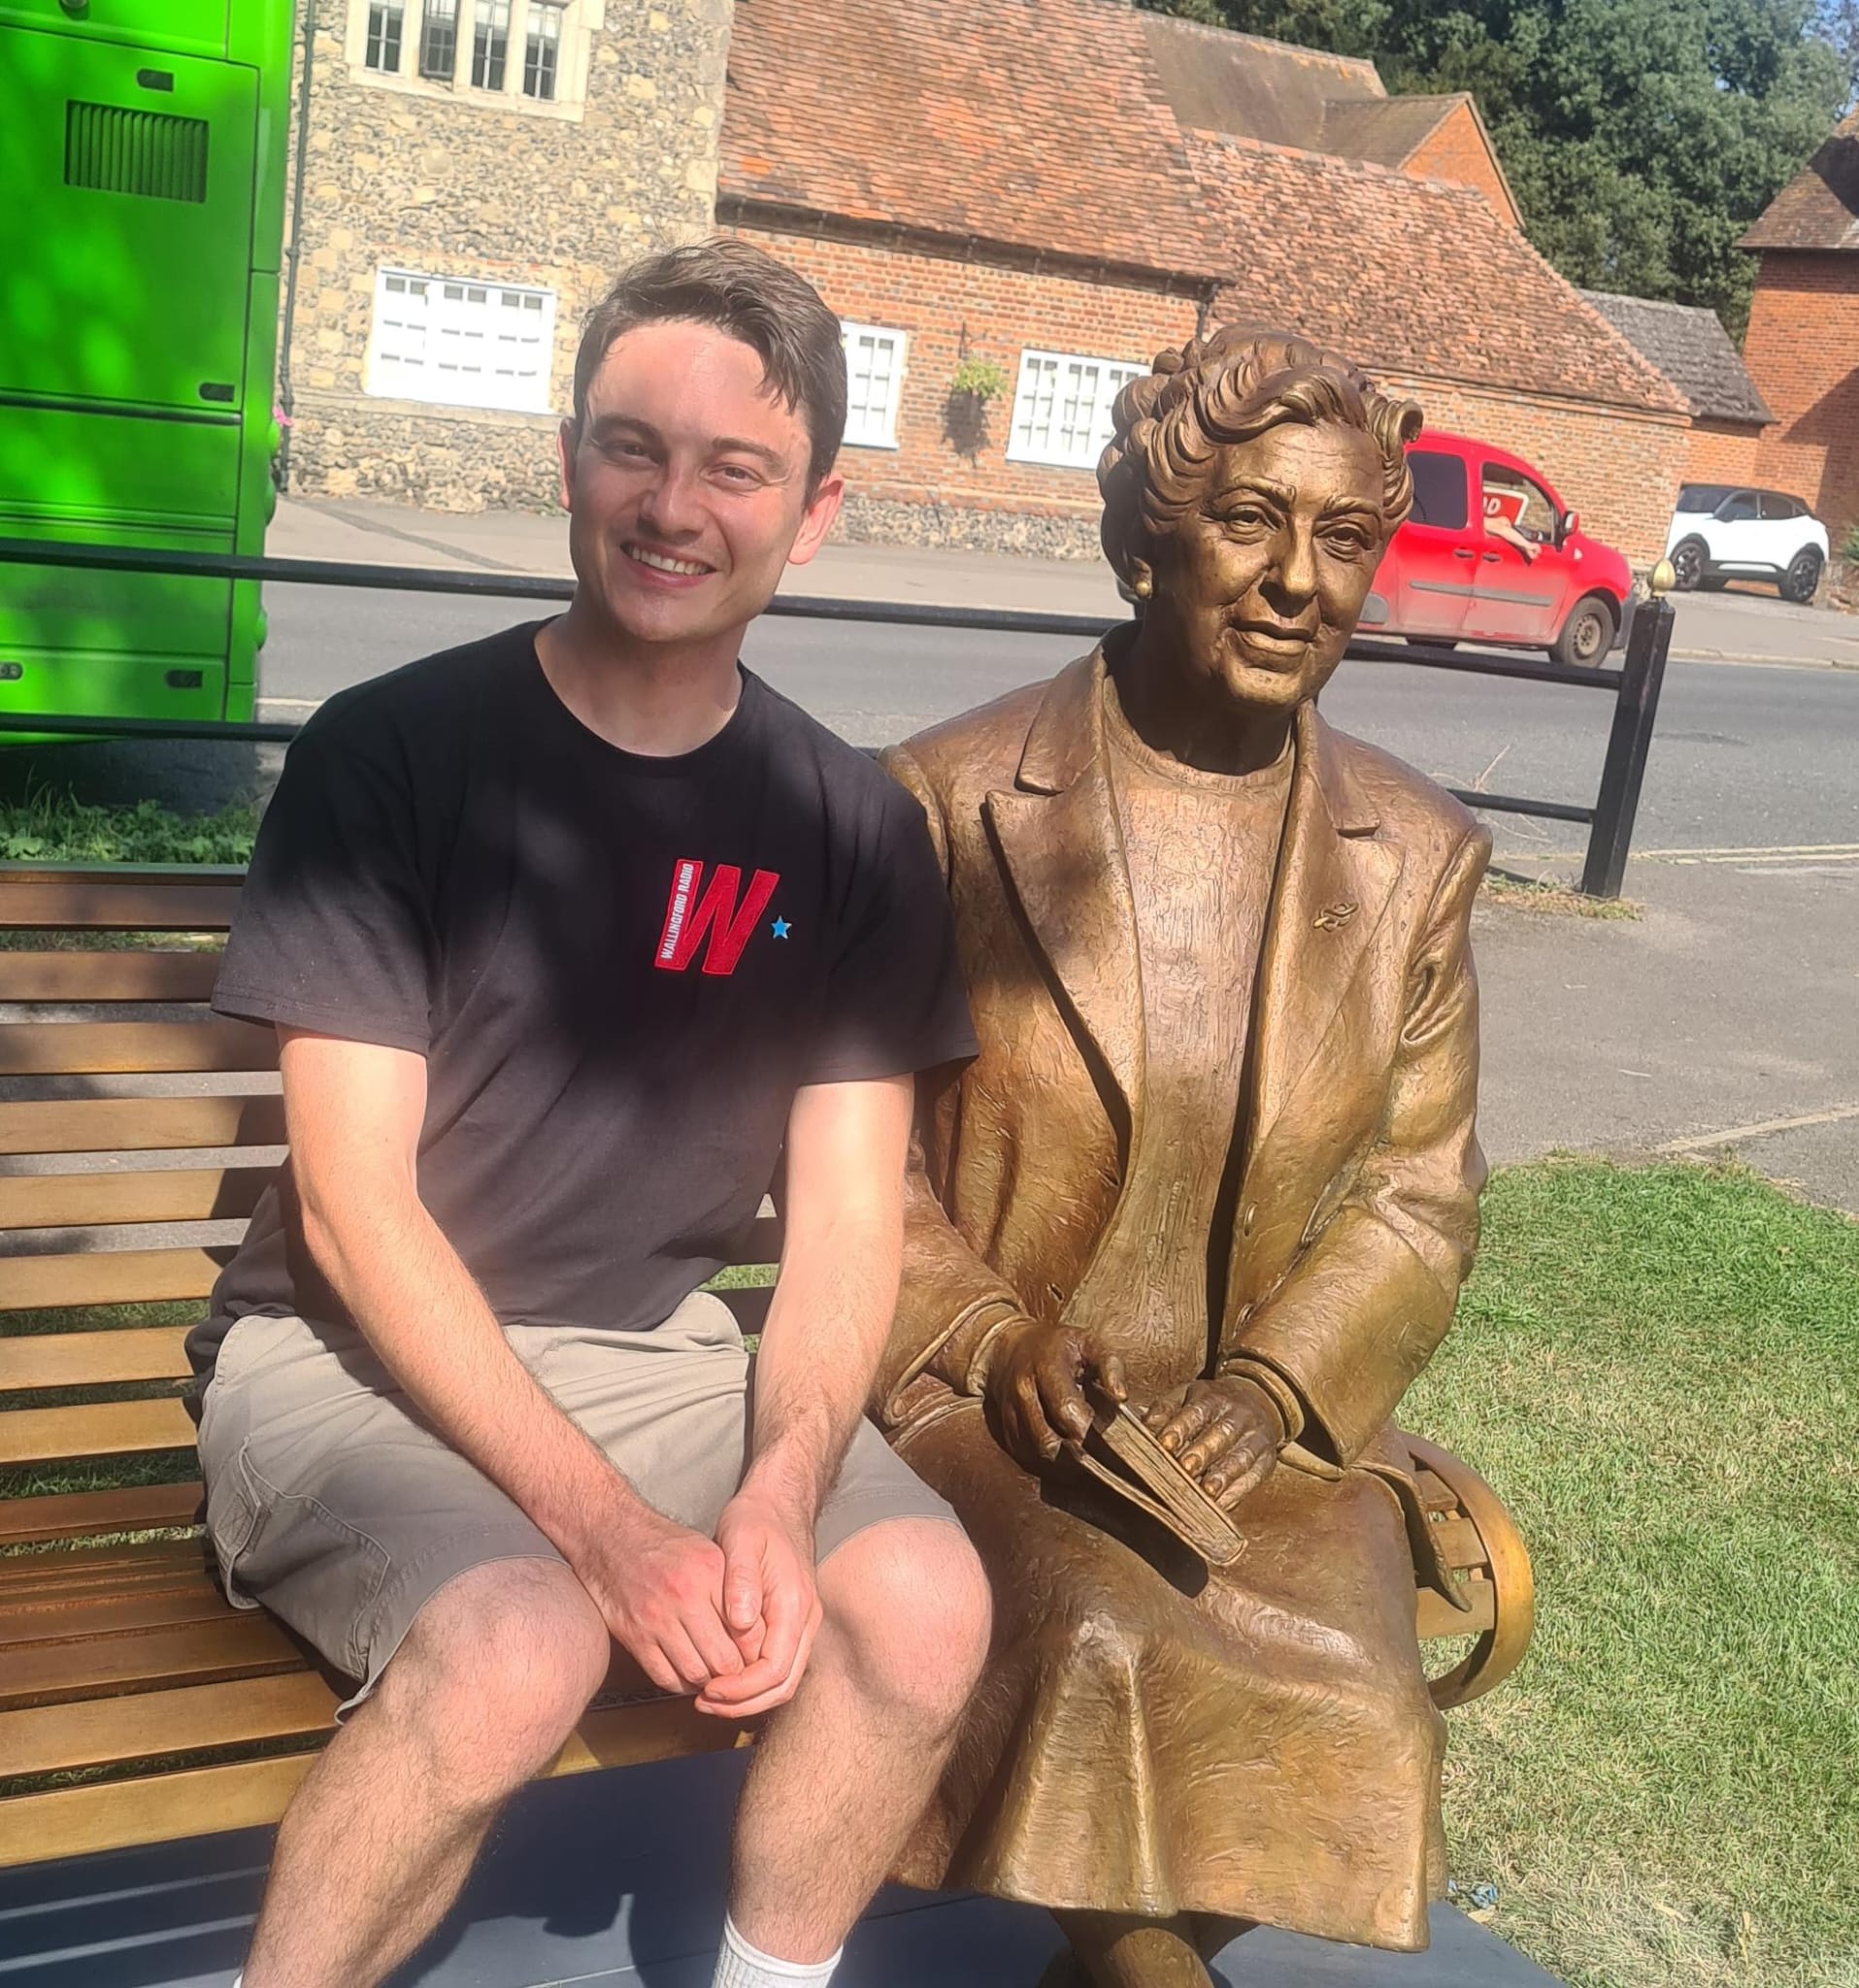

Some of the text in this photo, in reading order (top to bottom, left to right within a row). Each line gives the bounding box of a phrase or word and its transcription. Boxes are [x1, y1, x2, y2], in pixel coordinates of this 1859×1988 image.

[654, 858, 780, 975] W
[660, 863, 694, 959] WALLINGFORD RADIO
